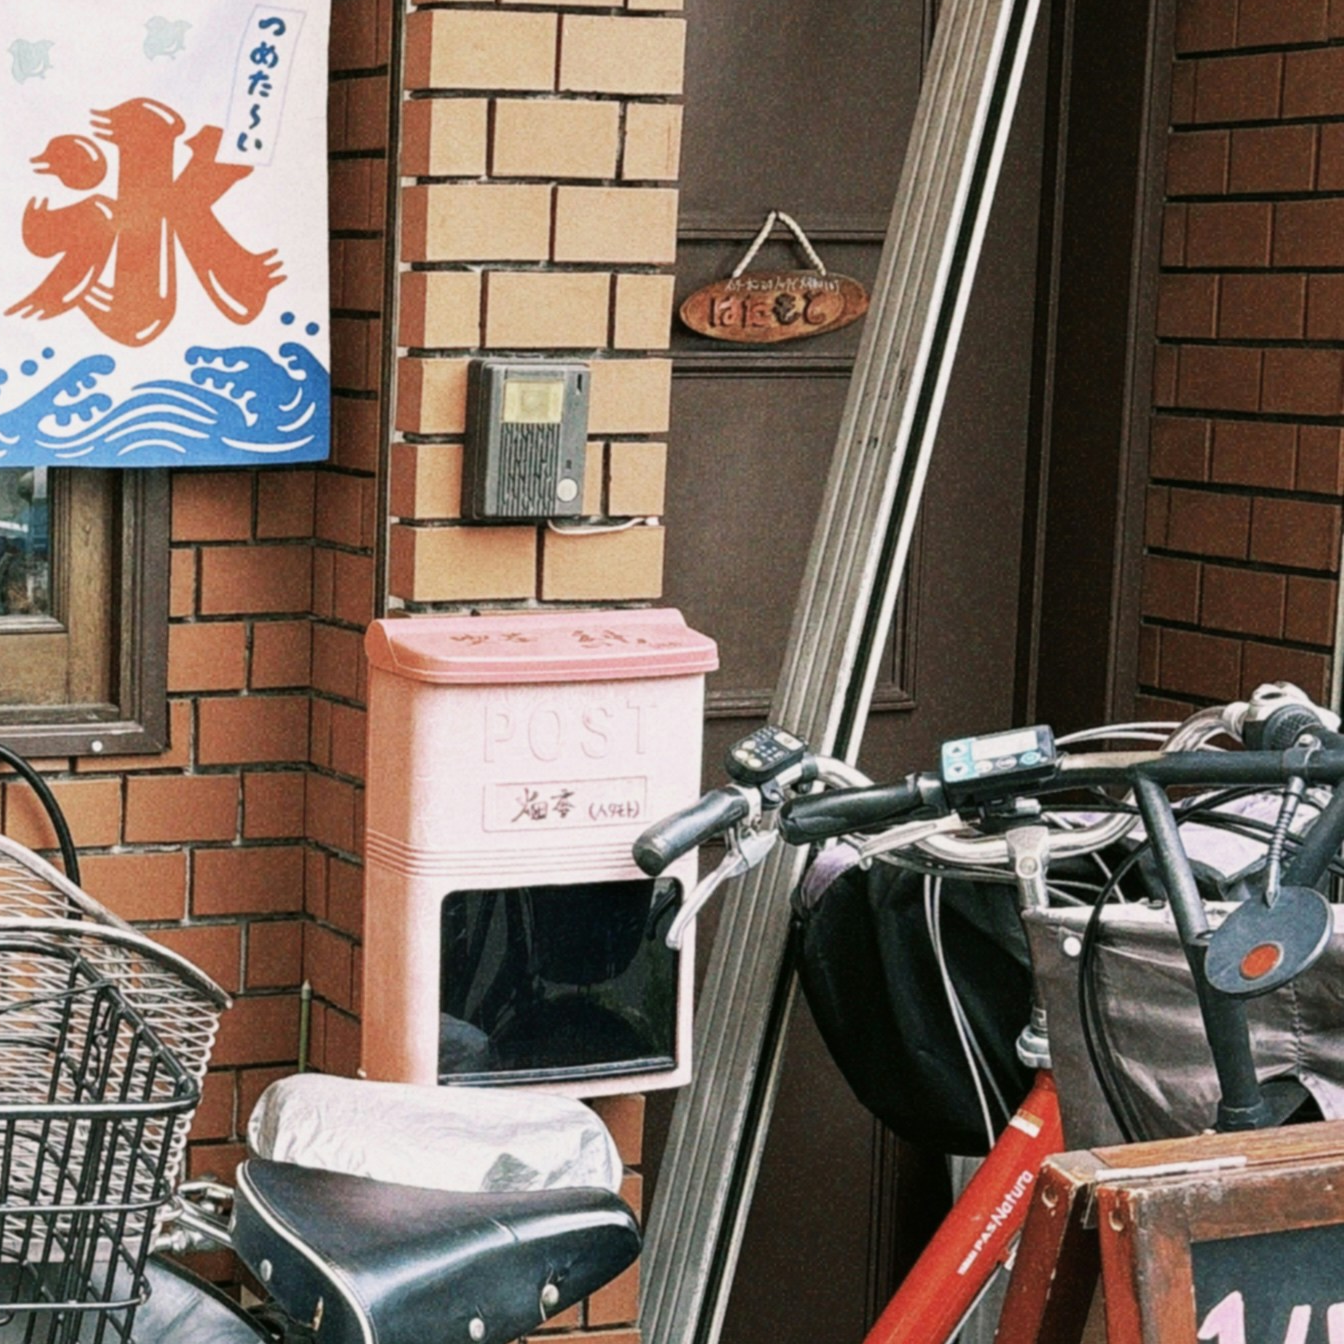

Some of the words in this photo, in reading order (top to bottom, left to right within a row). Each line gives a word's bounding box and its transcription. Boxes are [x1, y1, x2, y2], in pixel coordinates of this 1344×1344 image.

[3, 96, 288, 349] 氷
[482, 700, 658, 763] POST
[991, 1169, 1034, 1227] Natura
